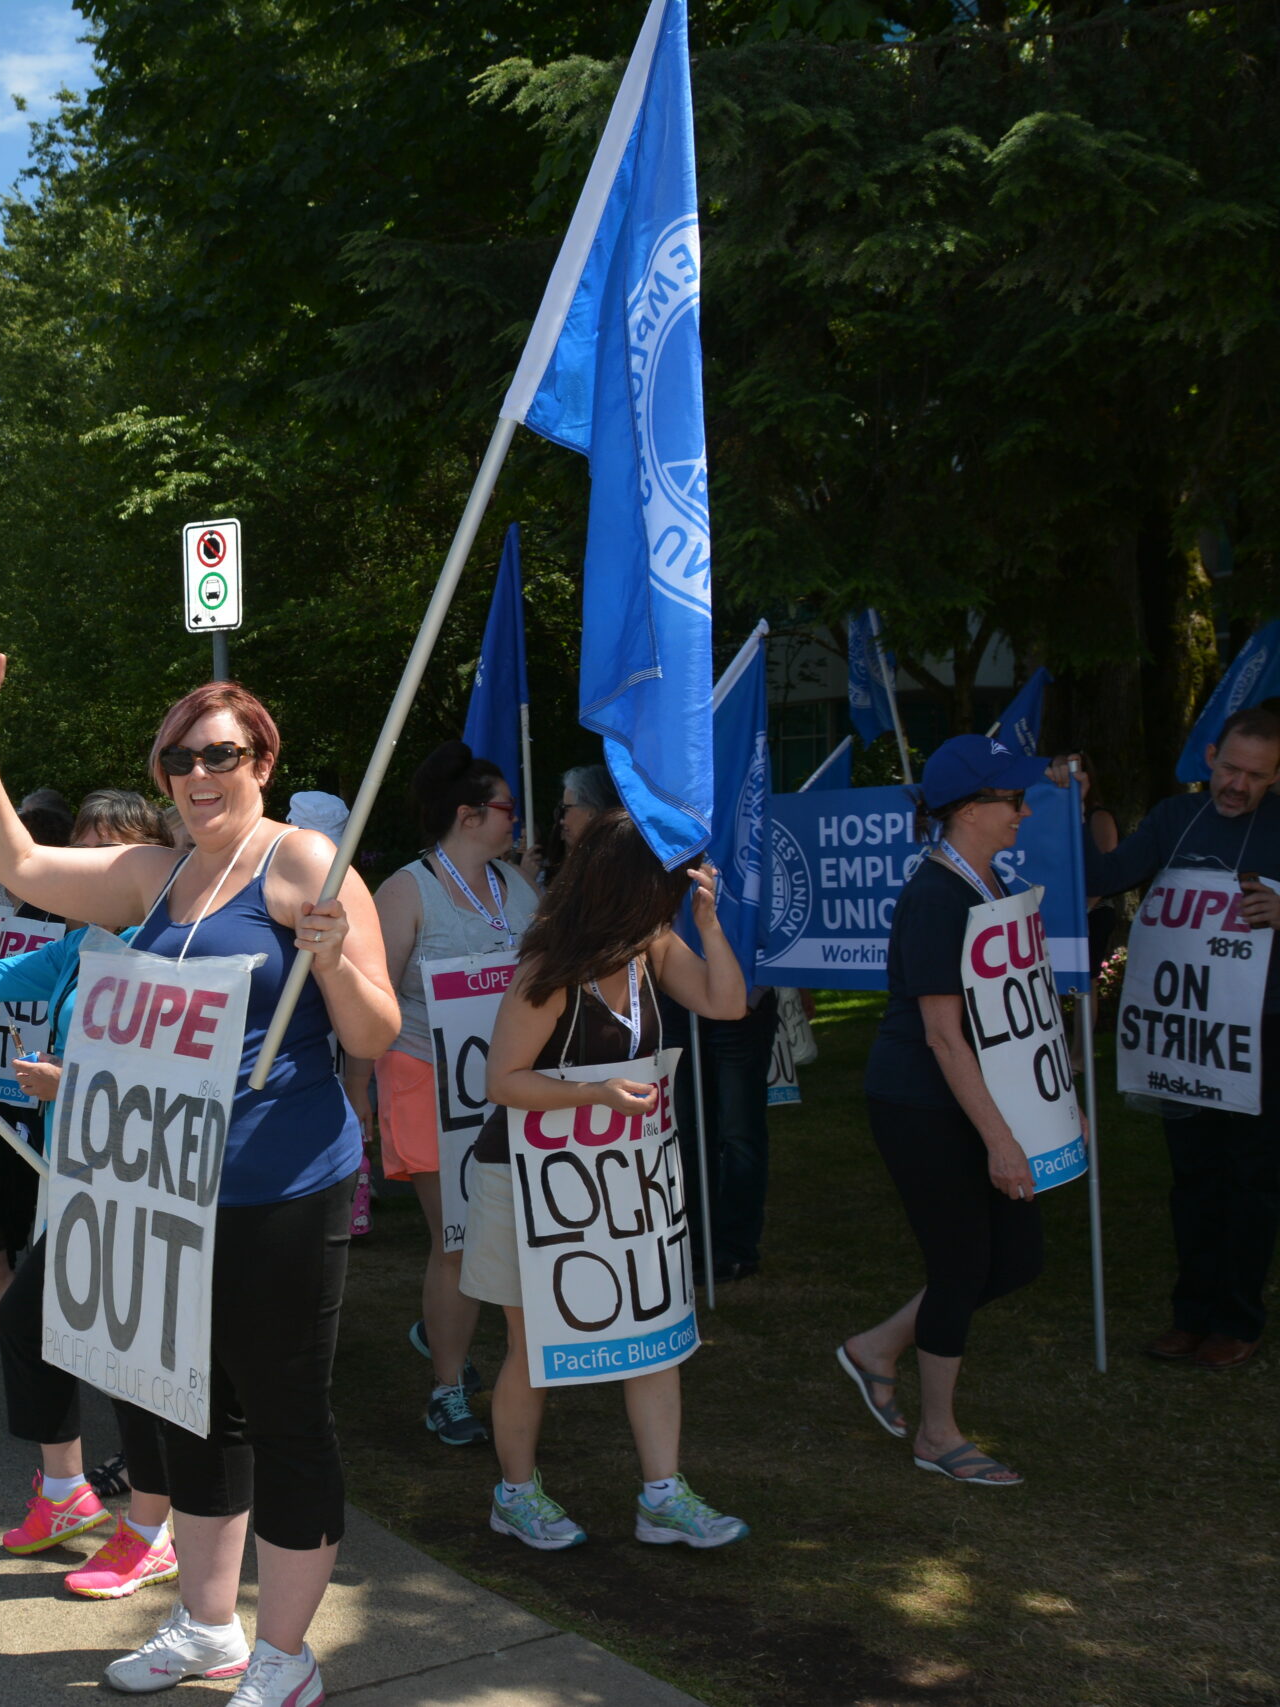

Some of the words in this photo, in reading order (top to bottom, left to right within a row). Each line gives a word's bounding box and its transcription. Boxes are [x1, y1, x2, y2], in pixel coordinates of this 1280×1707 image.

[818, 811, 920, 847] HOSPI
[781, 870, 806, 938] UNION
[1140, 887, 1251, 933] CUPE
[821, 944, 887, 963] Workin
[1206, 937, 1252, 960] 1816
[467, 971, 510, 991] CUPE
[1154, 960, 1210, 1012] ON
[82, 976, 229, 1060] CUPE
[1121, 1004, 1251, 1074] STRIKE
[198, 1080, 222, 1098] 1816
[57, 1062, 226, 1208] LOCKED
[1034, 1148, 1078, 1178] Pacific
[54, 1191, 205, 1372] OUT
[553, 1224, 687, 1332] OUT
[554, 1346, 622, 1372] Pacific
[627, 1340, 667, 1364] Blue
[669, 1326, 695, 1352] Cross
[45, 1327, 99, 1382] PACIFIC
[105, 1351, 146, 1404] BLUE
[152, 1376, 206, 1432] CROSS
